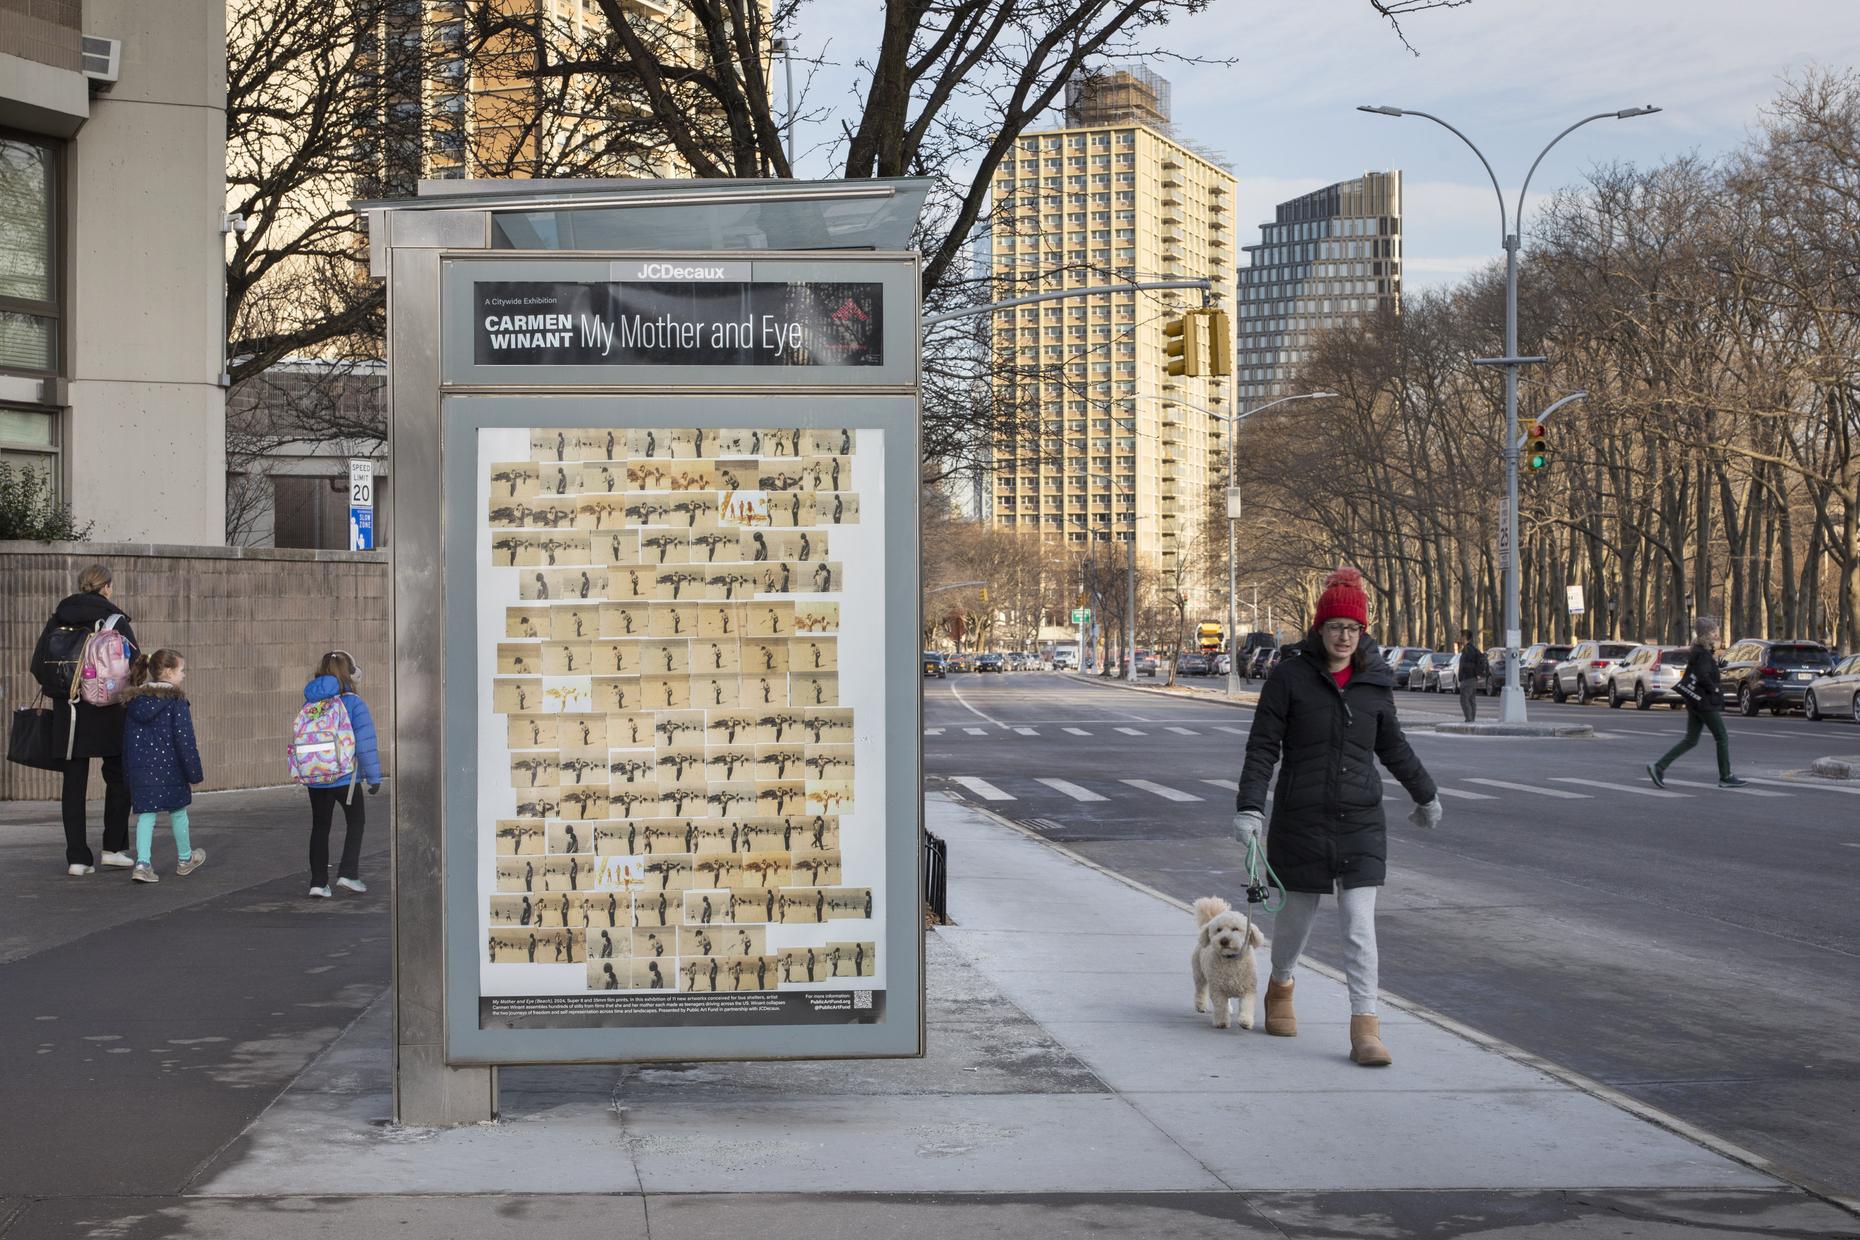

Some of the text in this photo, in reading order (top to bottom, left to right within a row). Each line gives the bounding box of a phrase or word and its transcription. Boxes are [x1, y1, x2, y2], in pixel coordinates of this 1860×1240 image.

[637, 264, 724, 279] JCDecaux
[491, 298, 522, 307] Citywide
[523, 297, 557, 305] Exhibition
[485, 314, 572, 331] CARMEN
[491, 333, 573, 349] WINANT
[581, 314, 803, 357] My Mother and Eye
[352, 464, 370, 472] SPEED
[353, 485, 370, 502] 20
[1500, 528, 1508, 547] 25
